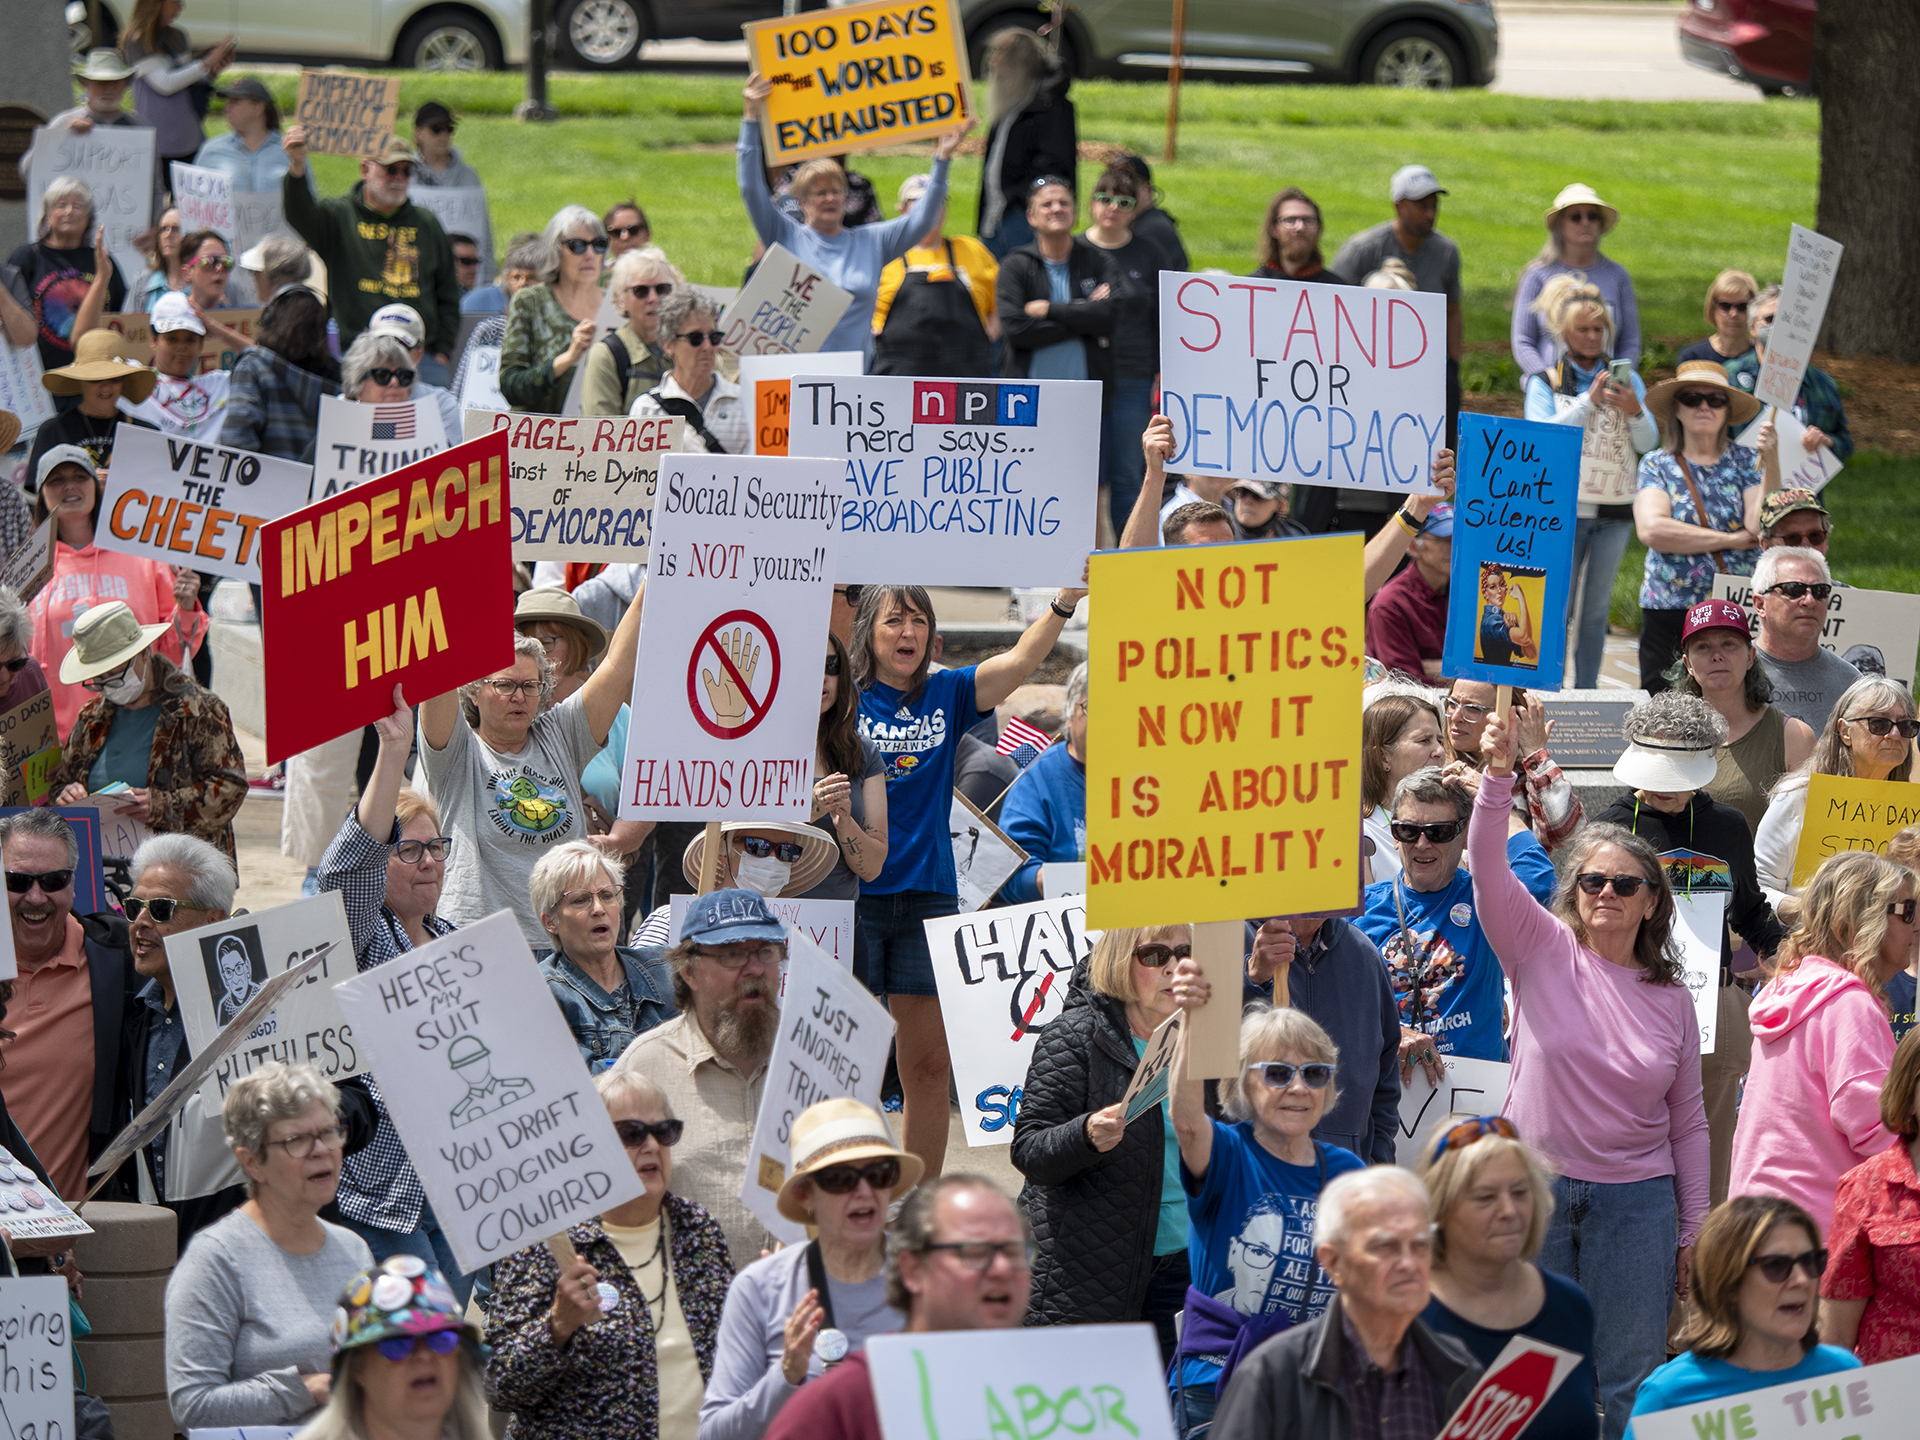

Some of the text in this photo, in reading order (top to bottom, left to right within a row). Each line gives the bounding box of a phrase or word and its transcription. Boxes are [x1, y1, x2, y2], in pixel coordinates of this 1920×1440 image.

[774, 5, 937, 60] 100 DAYS
[816, 54, 923, 98] WORLD
[929, 61, 946, 79] IS
[776, 82, 968, 152] EXHAUSTED!
[51, 142, 148, 174] SUPPORT
[789, 263, 822, 301] WE
[751, 300, 811, 354] PEOPLE
[782, 289, 810, 321] THE
[1177, 278, 1428, 369] STAND
[798, 382, 1031, 427] This npr
[1256, 359, 1351, 406] FOR
[591, 418, 674, 453] RAGE
[846, 424, 1036, 459] nerd says...
[1162, 390, 1446, 488] DEMOCRACY
[1481, 428, 1541, 478] You
[167, 438, 262, 487] VETO
[564, 459, 598, 483] the
[603, 458, 659, 496] Dying
[845, 456, 1024, 498] AVE PUBLIC
[182, 479, 226, 509] THE
[552, 487, 573, 506] OF
[664, 471, 843, 531] Social Security
[1488, 466, 1555, 505] Can't
[108, 487, 262, 570] CHEET
[280, 454, 502, 601] IMPEACH
[510, 506, 653, 548] DEMOCRAC
[841, 496, 1061, 537] BROADCASTING
[1464, 498, 1564, 532] Silence
[656, 541, 826, 587] is NOT yours!!
[1176, 562, 1279, 611] NOT
[344, 586, 449, 690] HIM
[1117, 625, 1361, 683] POLITICS,
[20, 694, 51, 723] DAYS
[1771, 690, 1825, 703] OXTROT
[857, 707, 947, 741] KANSAS
[876, 736, 936, 752] AYHAWKS
[1137, 694, 1314, 749] NOW IT
[1554, 748, 1598, 756] NOVEMBER
[630, 757, 808, 809] HANDS OFF!!
[1110, 758, 1350, 820] IS ABOUT
[518, 831, 538, 846] THE
[540, 809, 575, 845] BULLSHIT
[1826, 797, 1920, 826] MAY DAY
[1090, 827, 1343, 886] MORALITY.
[719, 916, 741, 925] CENTRAL
[378, 944, 484, 1015] HERE'S
[430, 985, 462, 1015] MY
[415, 1000, 482, 1051] SUIT
[811, 986, 859, 1044] JUST
[1424, 1010, 1472, 1034] MARCH
[790, 1016, 862, 1099] ANOTHER
[1436, 1042, 1455, 1054] 2024
[439, 1091, 580, 1175] YOU DRAFT
[455, 1133, 595, 1212] DODGING
[475, 1170, 613, 1253] COWARD
[1283, 1234, 1310, 1256] FOR
[1264, 1301, 1278, 1314] IS
[1270, 1281, 1287, 1297] OF
[1449, 1382, 1535, 1440] STOP
[1690, 1379, 1875, 1440] WE THE
